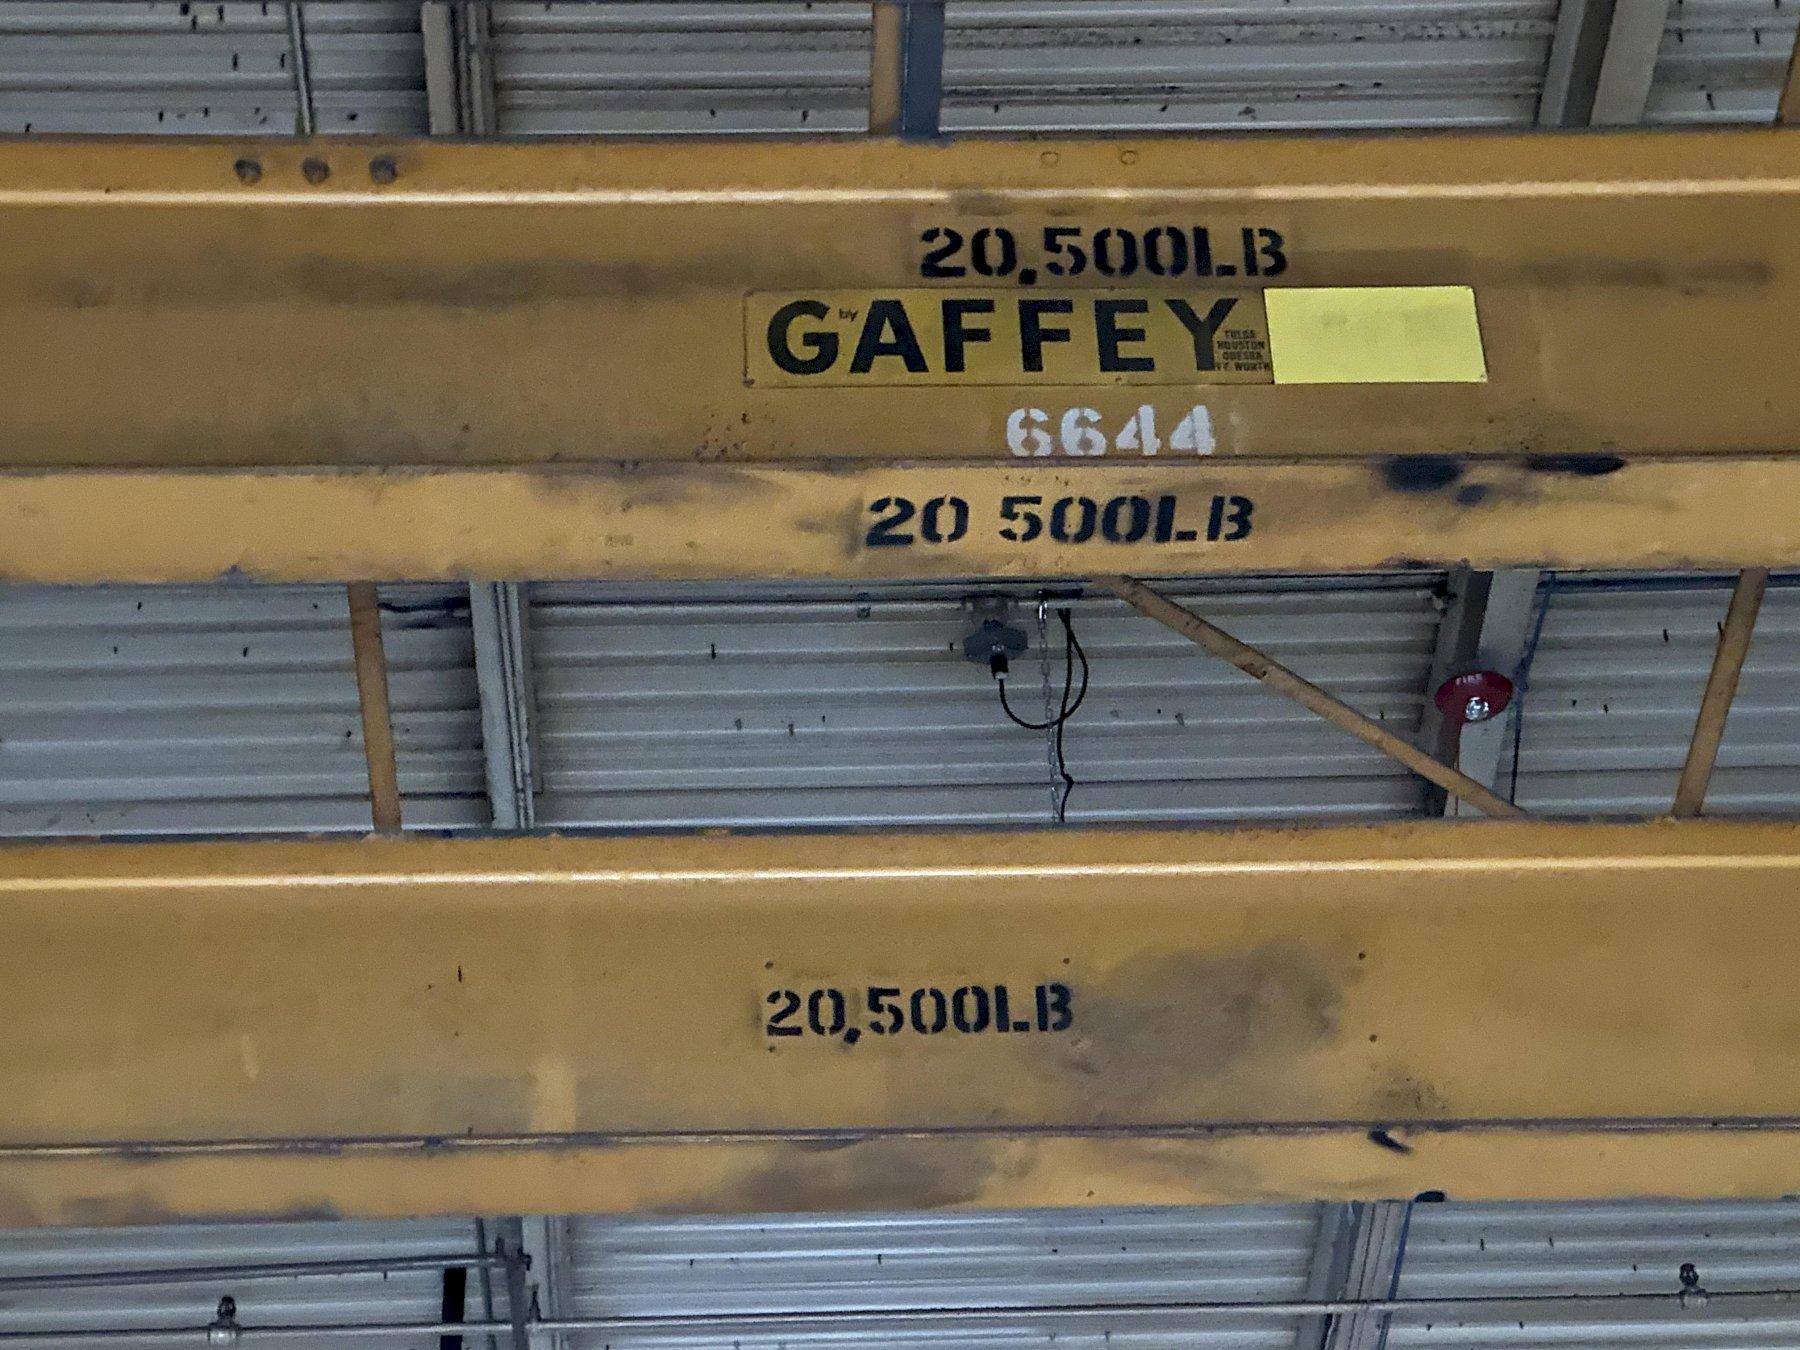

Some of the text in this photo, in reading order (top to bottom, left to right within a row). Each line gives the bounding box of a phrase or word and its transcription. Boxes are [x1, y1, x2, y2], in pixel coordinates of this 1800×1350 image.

[767, 299, 1239, 375] GAFFEY
[839, 307, 858, 322] by
[1217, 340, 1265, 351] HOUSTON
[1006, 404, 1216, 457] 6644
[865, 495, 1254, 547] 20 500LB
[766, 982, 1074, 1045] 20,500LB
